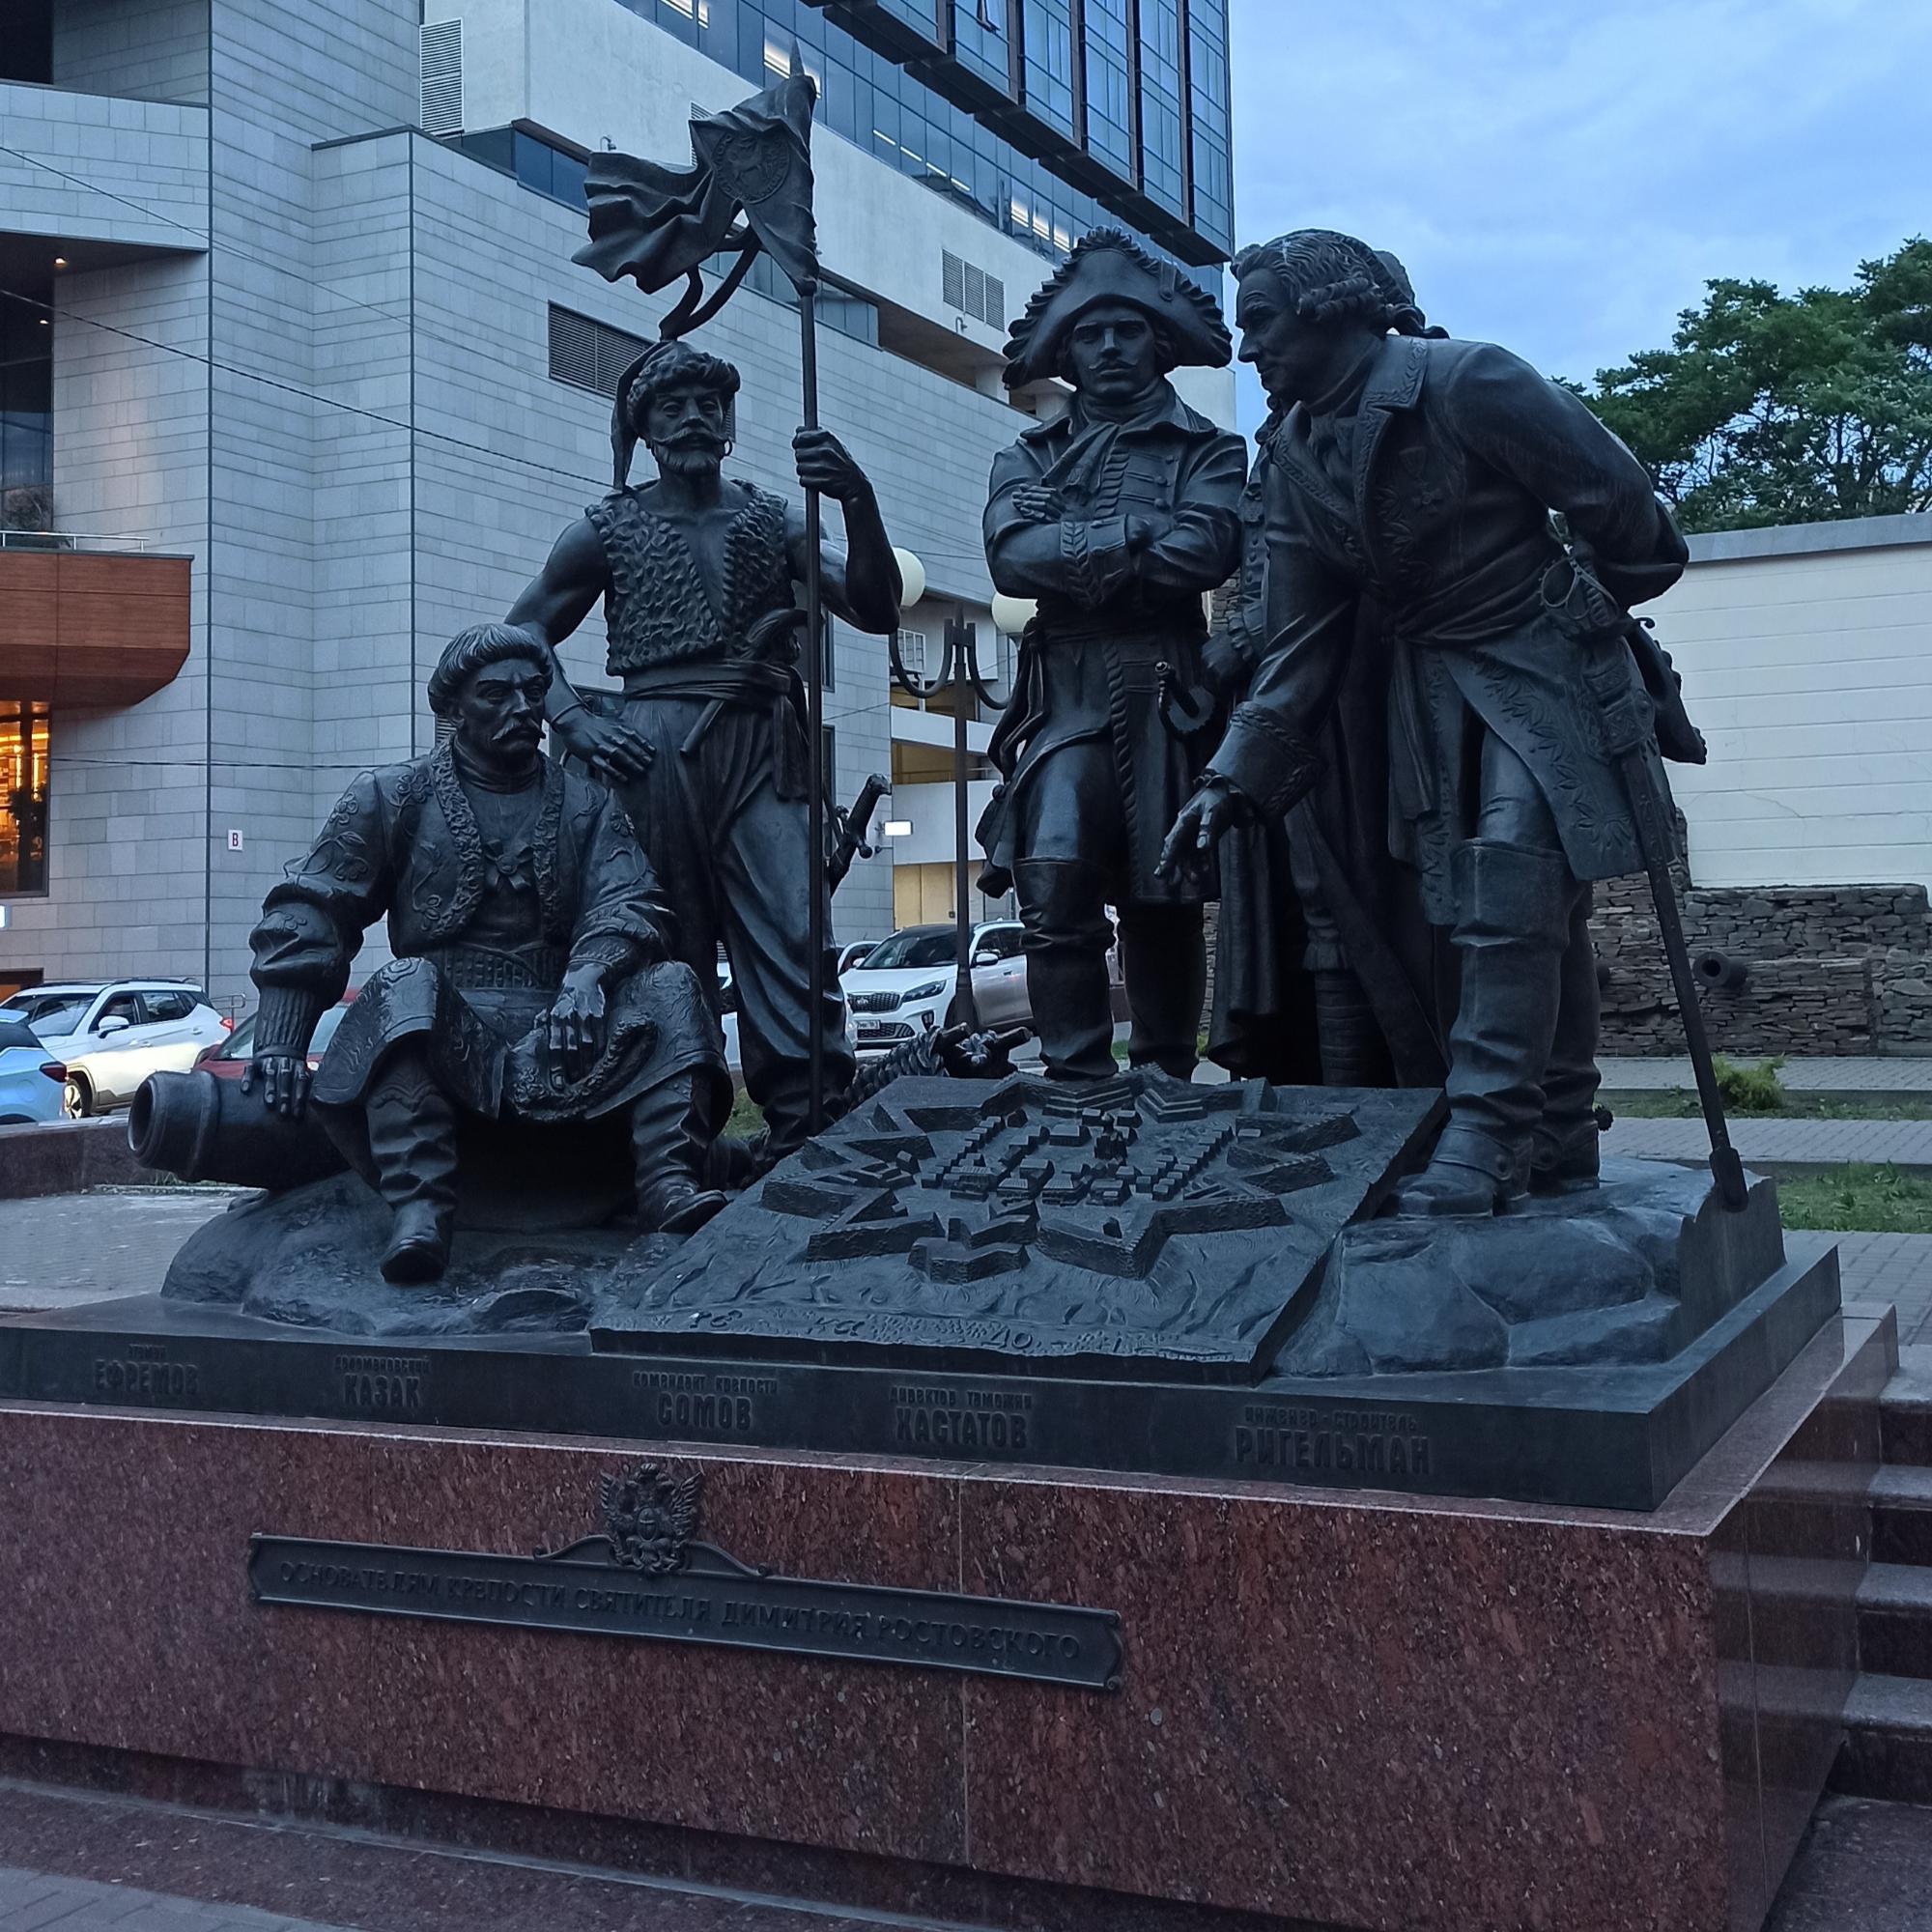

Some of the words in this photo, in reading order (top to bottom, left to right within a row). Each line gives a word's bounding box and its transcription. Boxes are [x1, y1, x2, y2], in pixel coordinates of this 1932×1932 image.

[94, 1358, 199, 1396] ЕФРЕМОВ
[343, 1373, 420, 1407] КАЗАК
[658, 1391, 753, 1431] СОМОВ
[895, 1406, 1029, 1450] ХАСТАТОВ
[1236, 1426, 1432, 1475] РИГЕЛЬМАН
[280, 1561, 440, 1596] ОСНОВАТЕЛЯМ
[447, 1577, 566, 1608] КРЕПОСТИ
[577, 1588, 711, 1620] СВЯТИТЕЛЯ
[722, 1600, 868, 1638] ДИМИТРИЯ
[878, 1614, 1081, 1659] РОСТОВСКОГО
